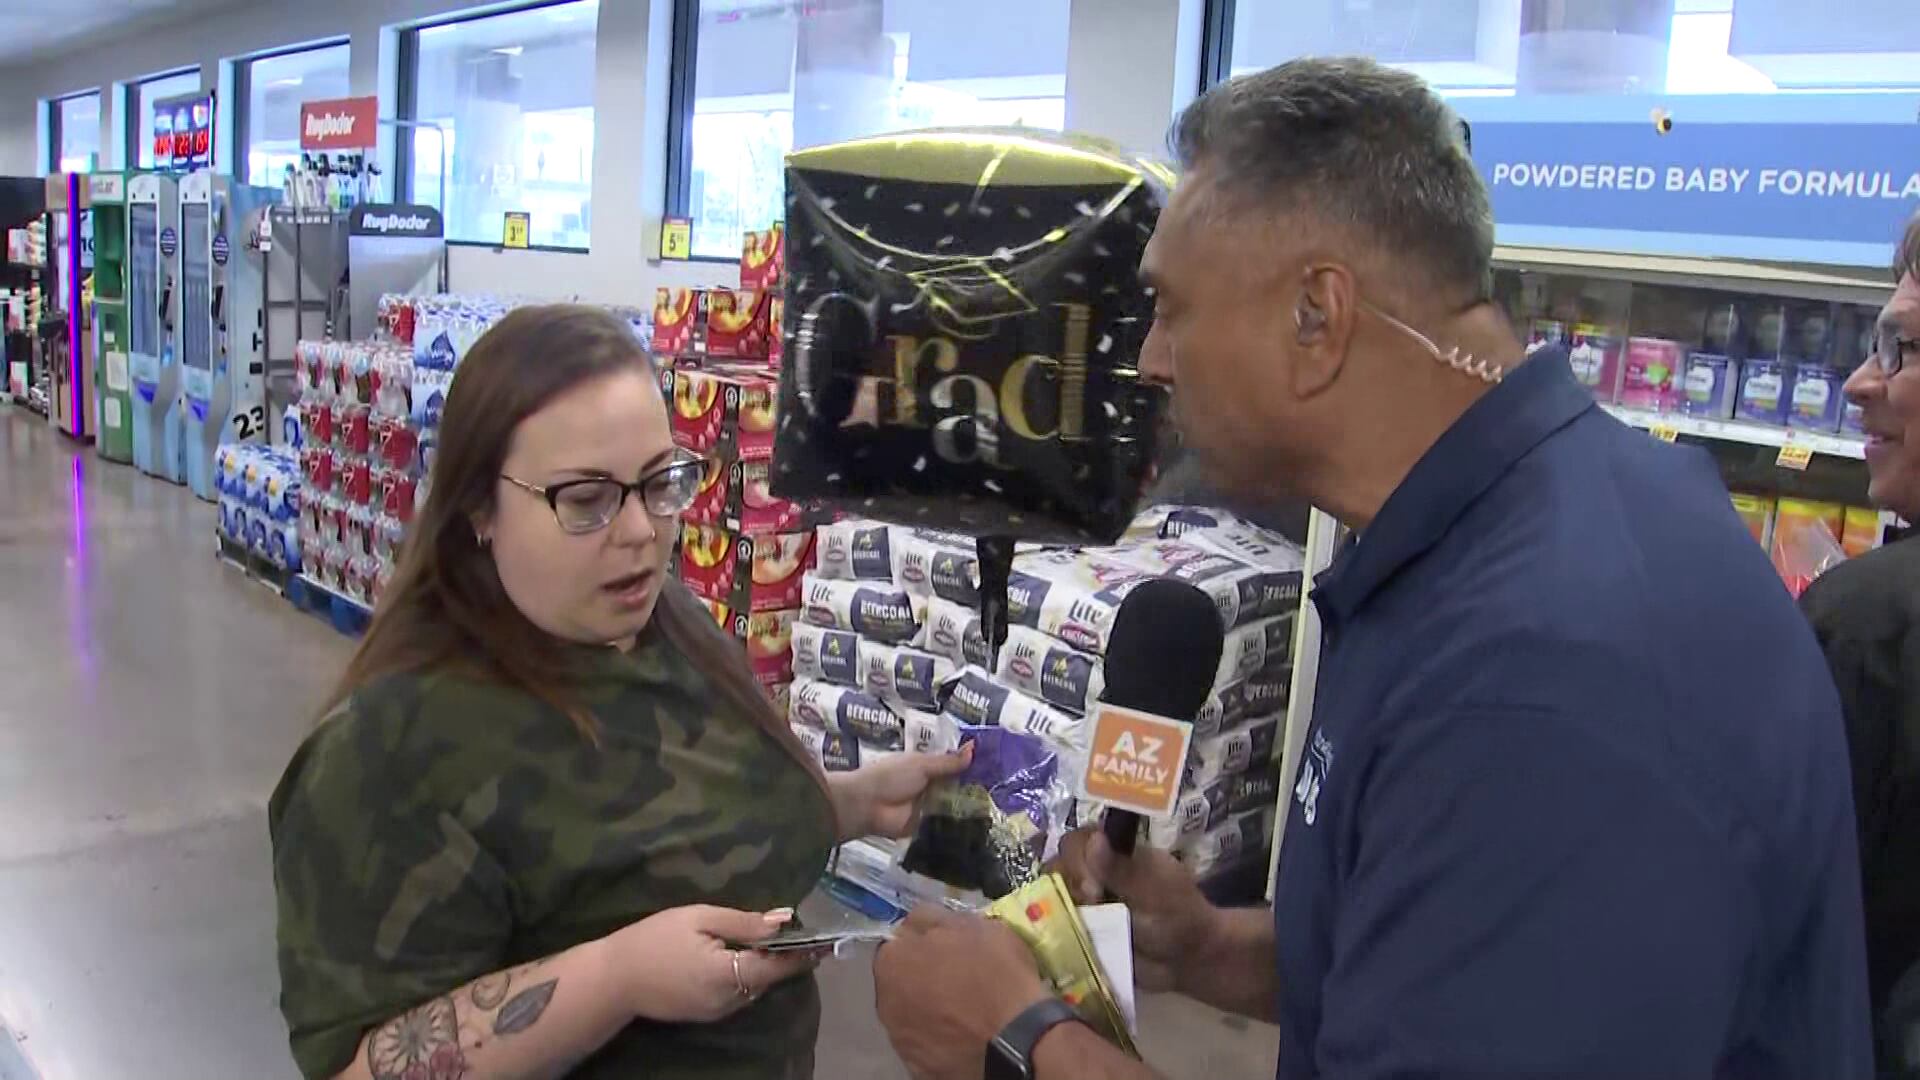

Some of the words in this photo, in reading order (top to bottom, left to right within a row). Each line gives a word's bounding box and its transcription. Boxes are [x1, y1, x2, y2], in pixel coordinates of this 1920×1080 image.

[1493, 163, 1656, 190] POWDERED
[1665, 167, 1750, 193] BABY
[1758, 169, 1920, 199] FORMULA
[795, 292, 1092, 463] Grad
[232, 406, 264, 440] 23
[860, 600, 911, 619] BEERCOAL
[1110, 730, 1164, 765] AZ
[1092, 752, 1169, 785] FAMILY
